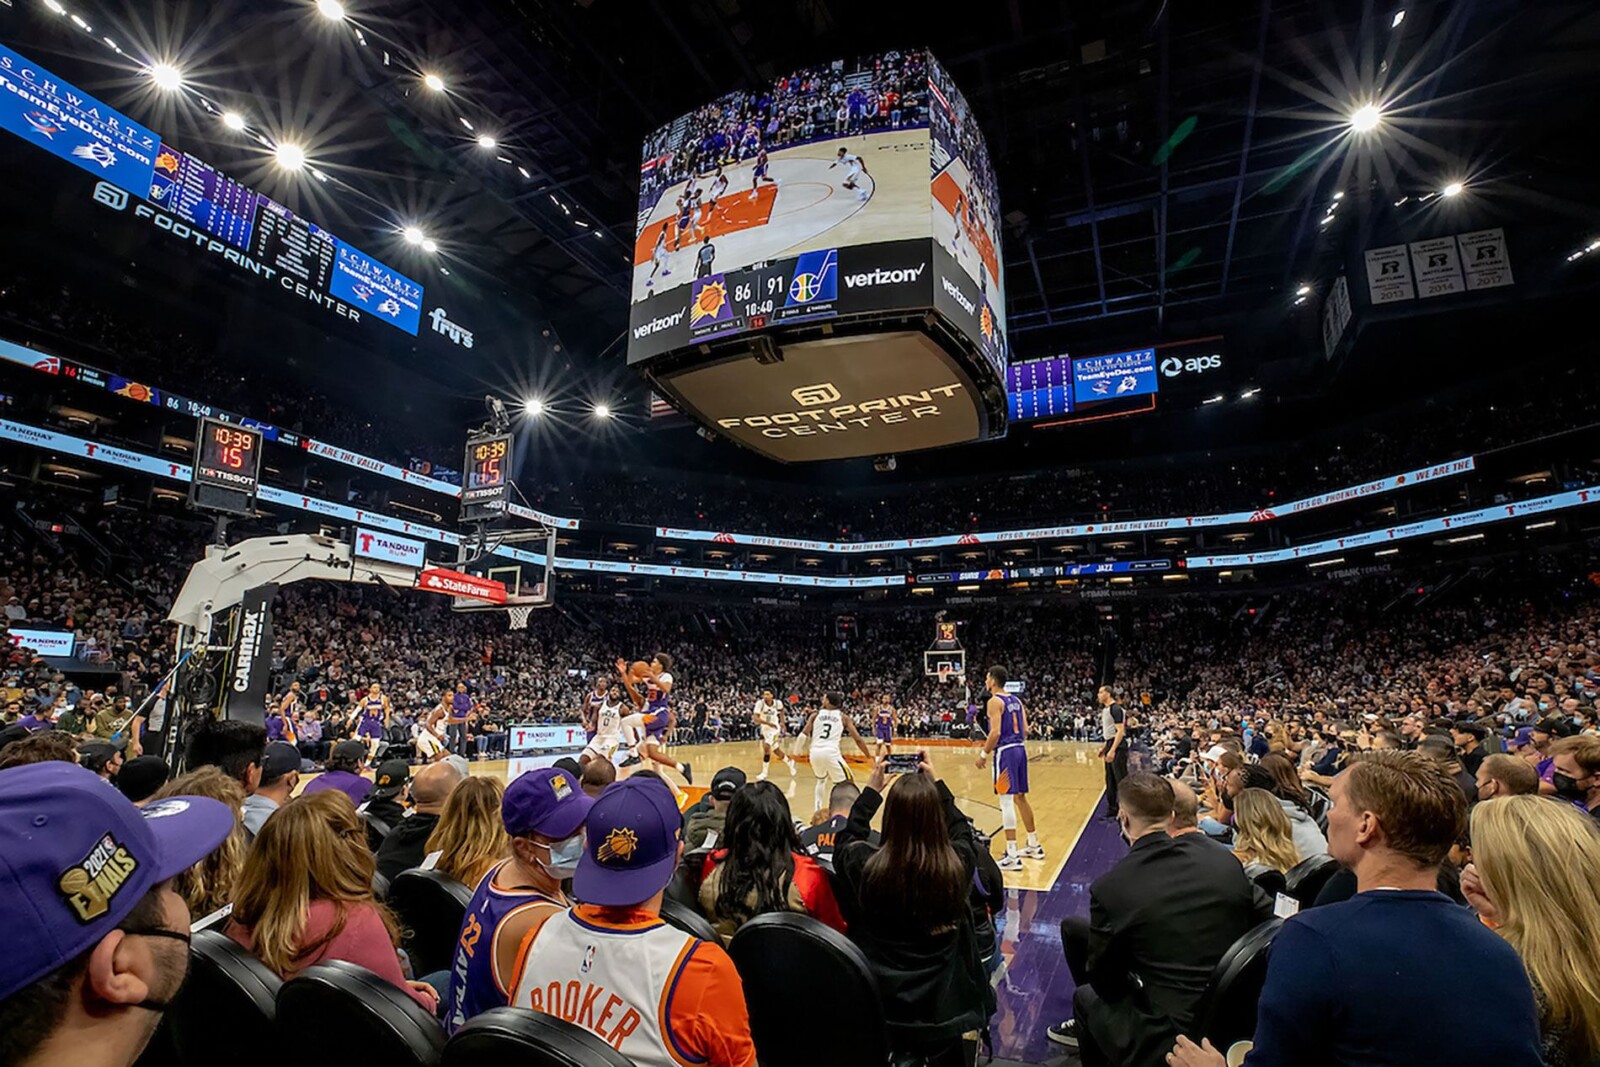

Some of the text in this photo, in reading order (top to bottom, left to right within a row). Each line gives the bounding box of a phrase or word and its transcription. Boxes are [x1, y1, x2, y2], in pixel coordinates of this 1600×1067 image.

[0, 56, 154, 149] SCHWARTZ
[23, 80, 60, 104] LASER
[92, 119, 133, 144] CENTER
[0, 75, 151, 166] TeamEyeDoc.com
[135, 205, 276, 279] FOOTPRINT
[280, 276, 361, 323] CENTER
[341, 248, 419, 296] SCHWARTZ
[844, 268, 917, 288] verizon
[1477, 276, 1503, 286] 2017
[735, 276, 783, 302] 86 91
[941, 276, 974, 316] verizon
[1380, 290, 1404, 300] 2013
[1428, 283, 1455, 294] 2014
[745, 300, 773, 317] 10:40
[633, 312, 682, 339] verizon
[1077, 351, 1152, 369] SCHWARTZ
[1184, 354, 1221, 373] aps
[64, 365, 77, 377] 16
[1077, 365, 1153, 381] TeamEyeDoc.com
[166, 397, 179, 410] 86
[188, 401, 211, 416] 10:40
[718, 383, 962, 429] FOOTPRINT
[762, 406, 941, 438] CENTER
[4, 424, 54, 441] TANDUAY
[215, 428, 252, 450] 10:39
[100, 448, 145, 463] TANDUAY
[223, 447, 242, 468] 15
[320, 444, 338, 457] ARE
[340, 449, 355, 463] THE
[357, 454, 385, 472] VALLEY
[475, 441, 506, 460] 10:39
[216, 470, 255, 485] TISSOT
[480, 458, 500, 485] 15
[1415, 461, 1470, 480] WE ARE THE
[476, 487, 504, 498] TISSOT
[1325, 488, 1358, 502] PHOENIX
[377, 539, 419, 555] TANDUAY
[389, 549, 407, 557] RUM
[959, 571, 980, 580] SUNS
[1010, 569, 1019, 578] 86
[1096, 563, 1113, 573] JAZZ
[27, 637, 68, 646] TANDUAY
[820, 723, 832, 739] 3
[1012, 712, 1020, 734] 1
[83, 843, 110, 878] 2021
[460, 913, 482, 958] 22
[530, 980, 641, 1051] BOOKER
